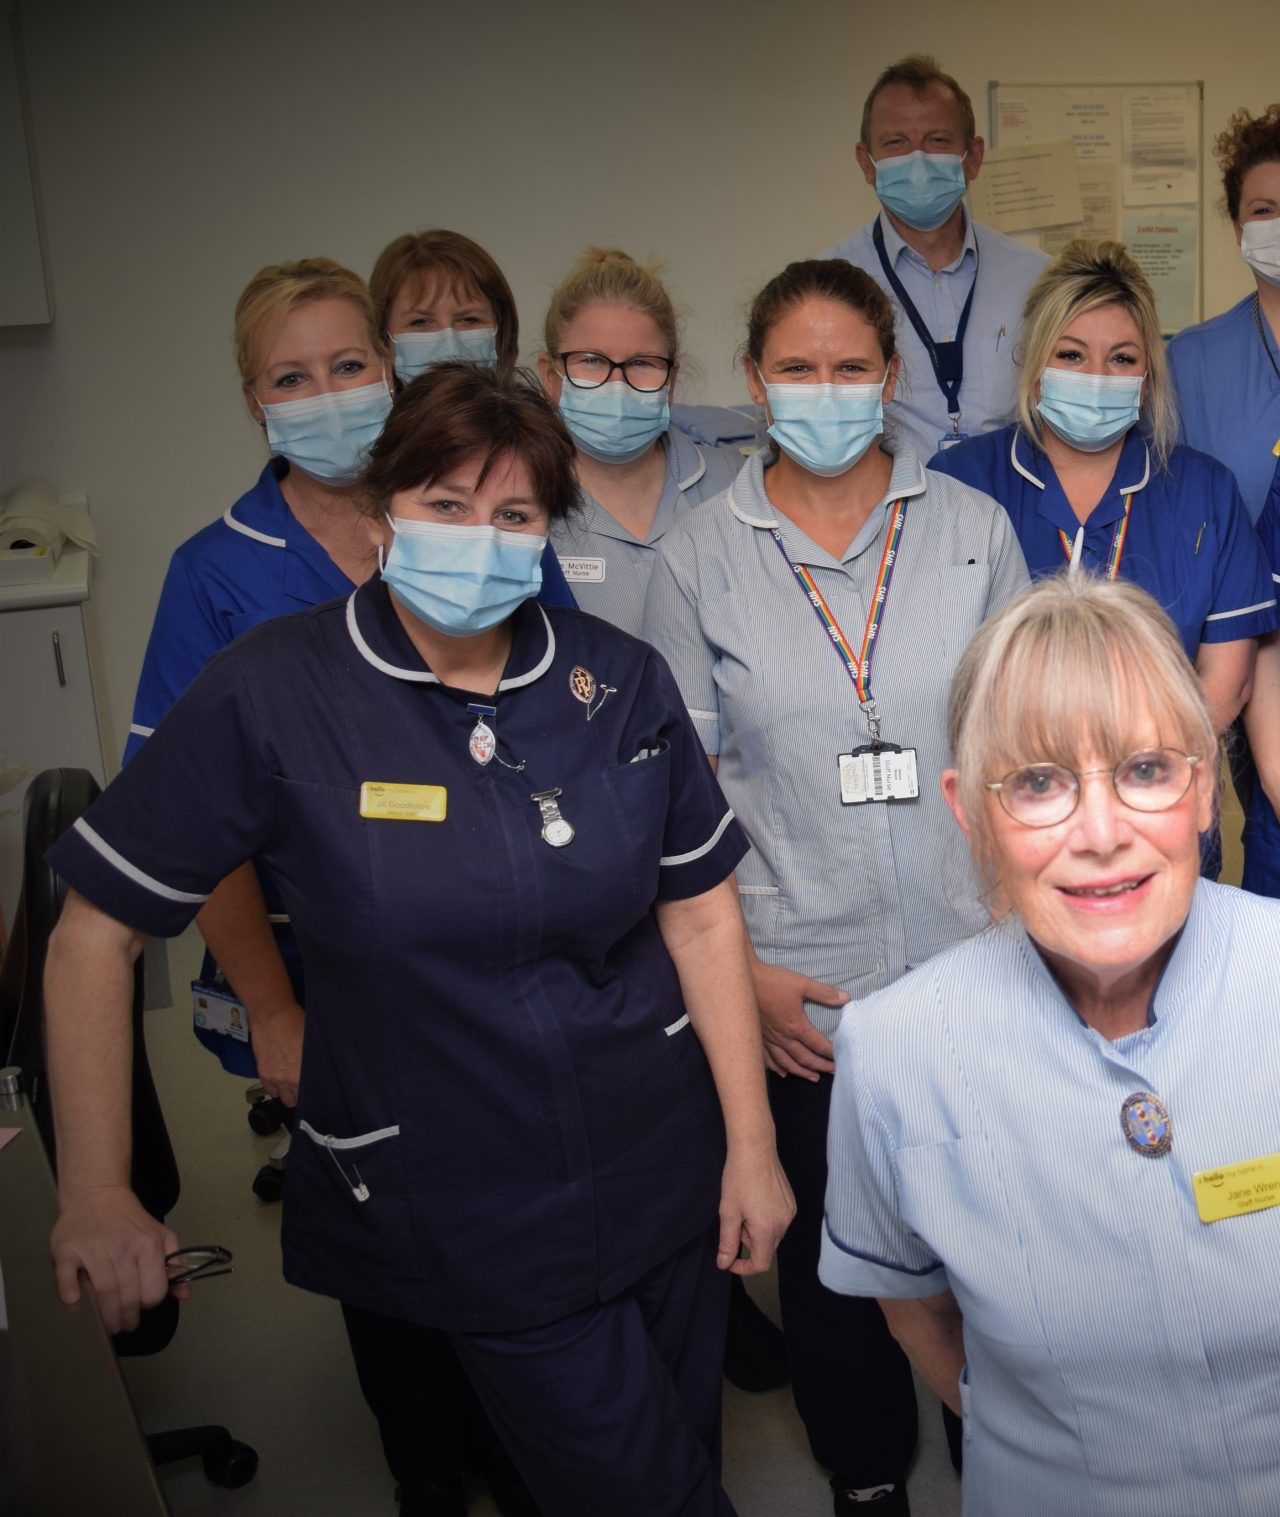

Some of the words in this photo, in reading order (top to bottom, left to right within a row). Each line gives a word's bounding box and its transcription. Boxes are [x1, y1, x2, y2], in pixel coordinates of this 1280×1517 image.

[894, 512, 904, 530] NHS
[885, 550, 895, 566] NHS
[568, 562, 599, 571] McVittie
[808, 590, 822, 607] NHS
[876, 586, 886, 603] NHS
[828, 626, 841, 642] NHS
[867, 623, 878, 639] NHS
[847, 661, 858, 679] NHS
[861, 660, 869, 678] NHS
[1202, 1172, 1224, 1184] hello
[1227, 1189, 1251, 1201] Jane
[1252, 1180, 1280, 1194] Wren
[1255, 1195, 1275, 1203] Nurse
